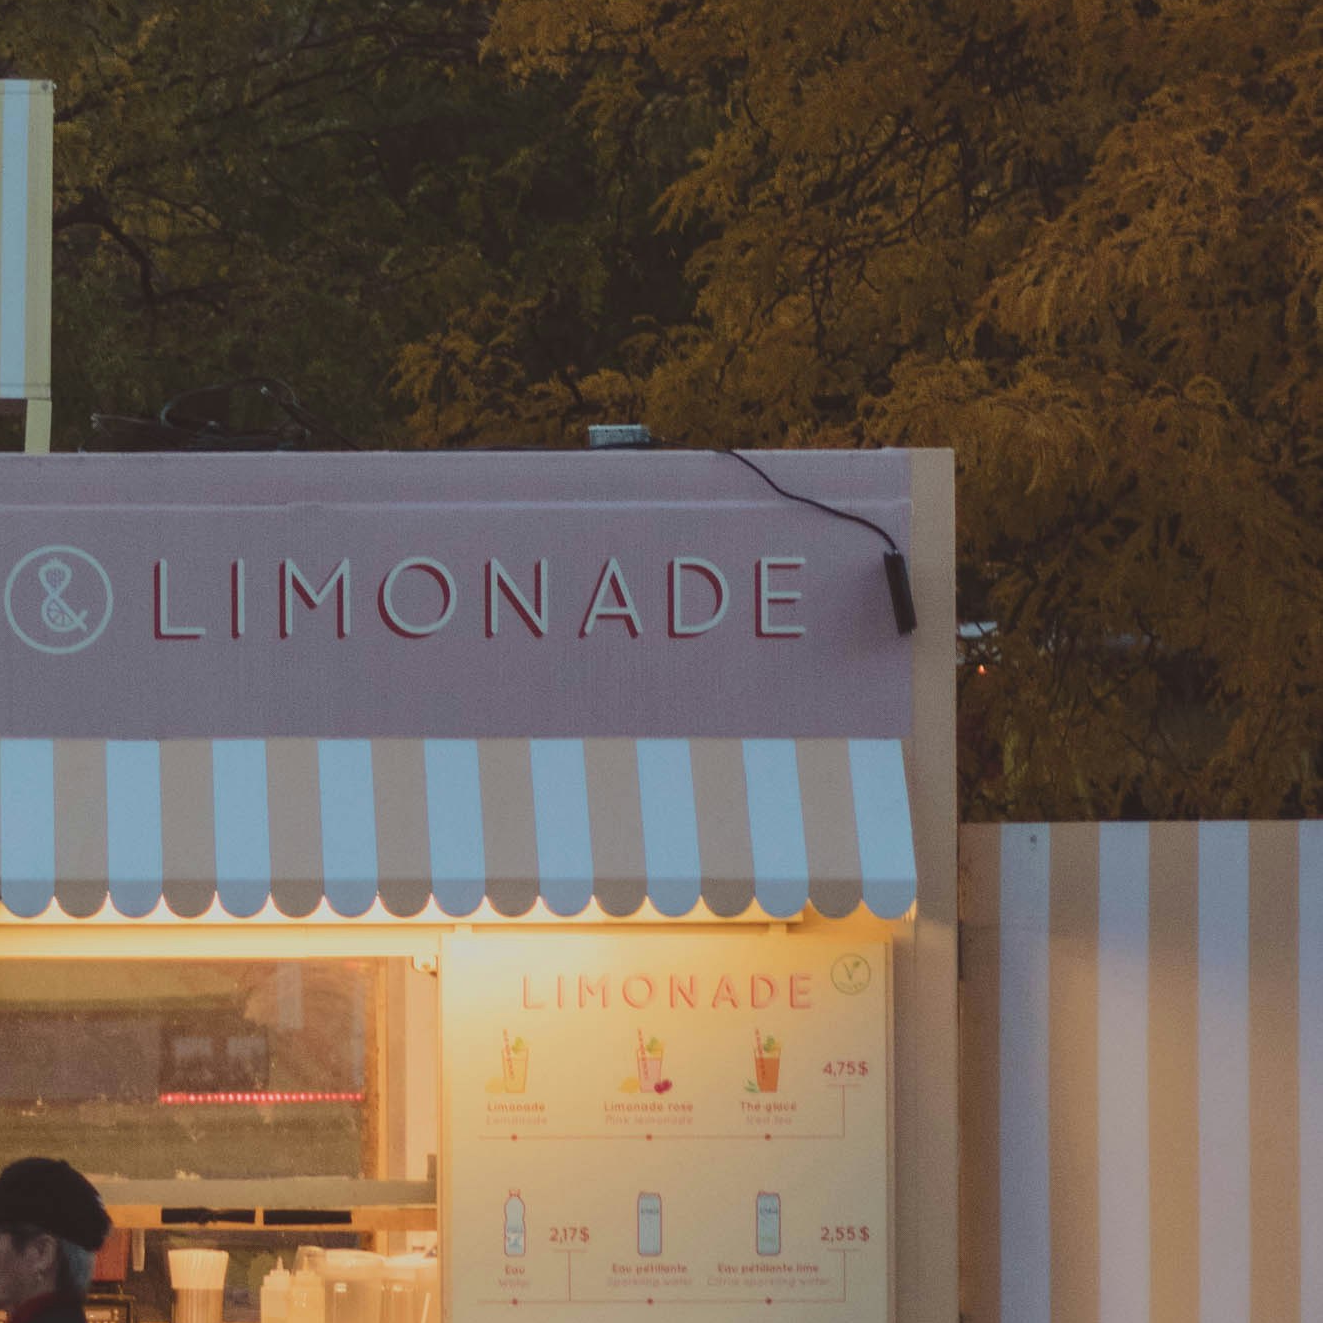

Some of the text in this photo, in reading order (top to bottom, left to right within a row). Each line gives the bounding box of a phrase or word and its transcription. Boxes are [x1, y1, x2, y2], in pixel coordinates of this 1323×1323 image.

[153, 556, 807, 639] LIMONADE
[521, 973, 813, 1010] LIMONADE
[487, 1101, 546, 1112] Limonade
[603, 1101, 694, 1112] Limonade rose
[505, 1263, 526, 1275] Eau
[612, 1263, 631, 1275] Eau
[717, 1263, 738, 1274] Eau
